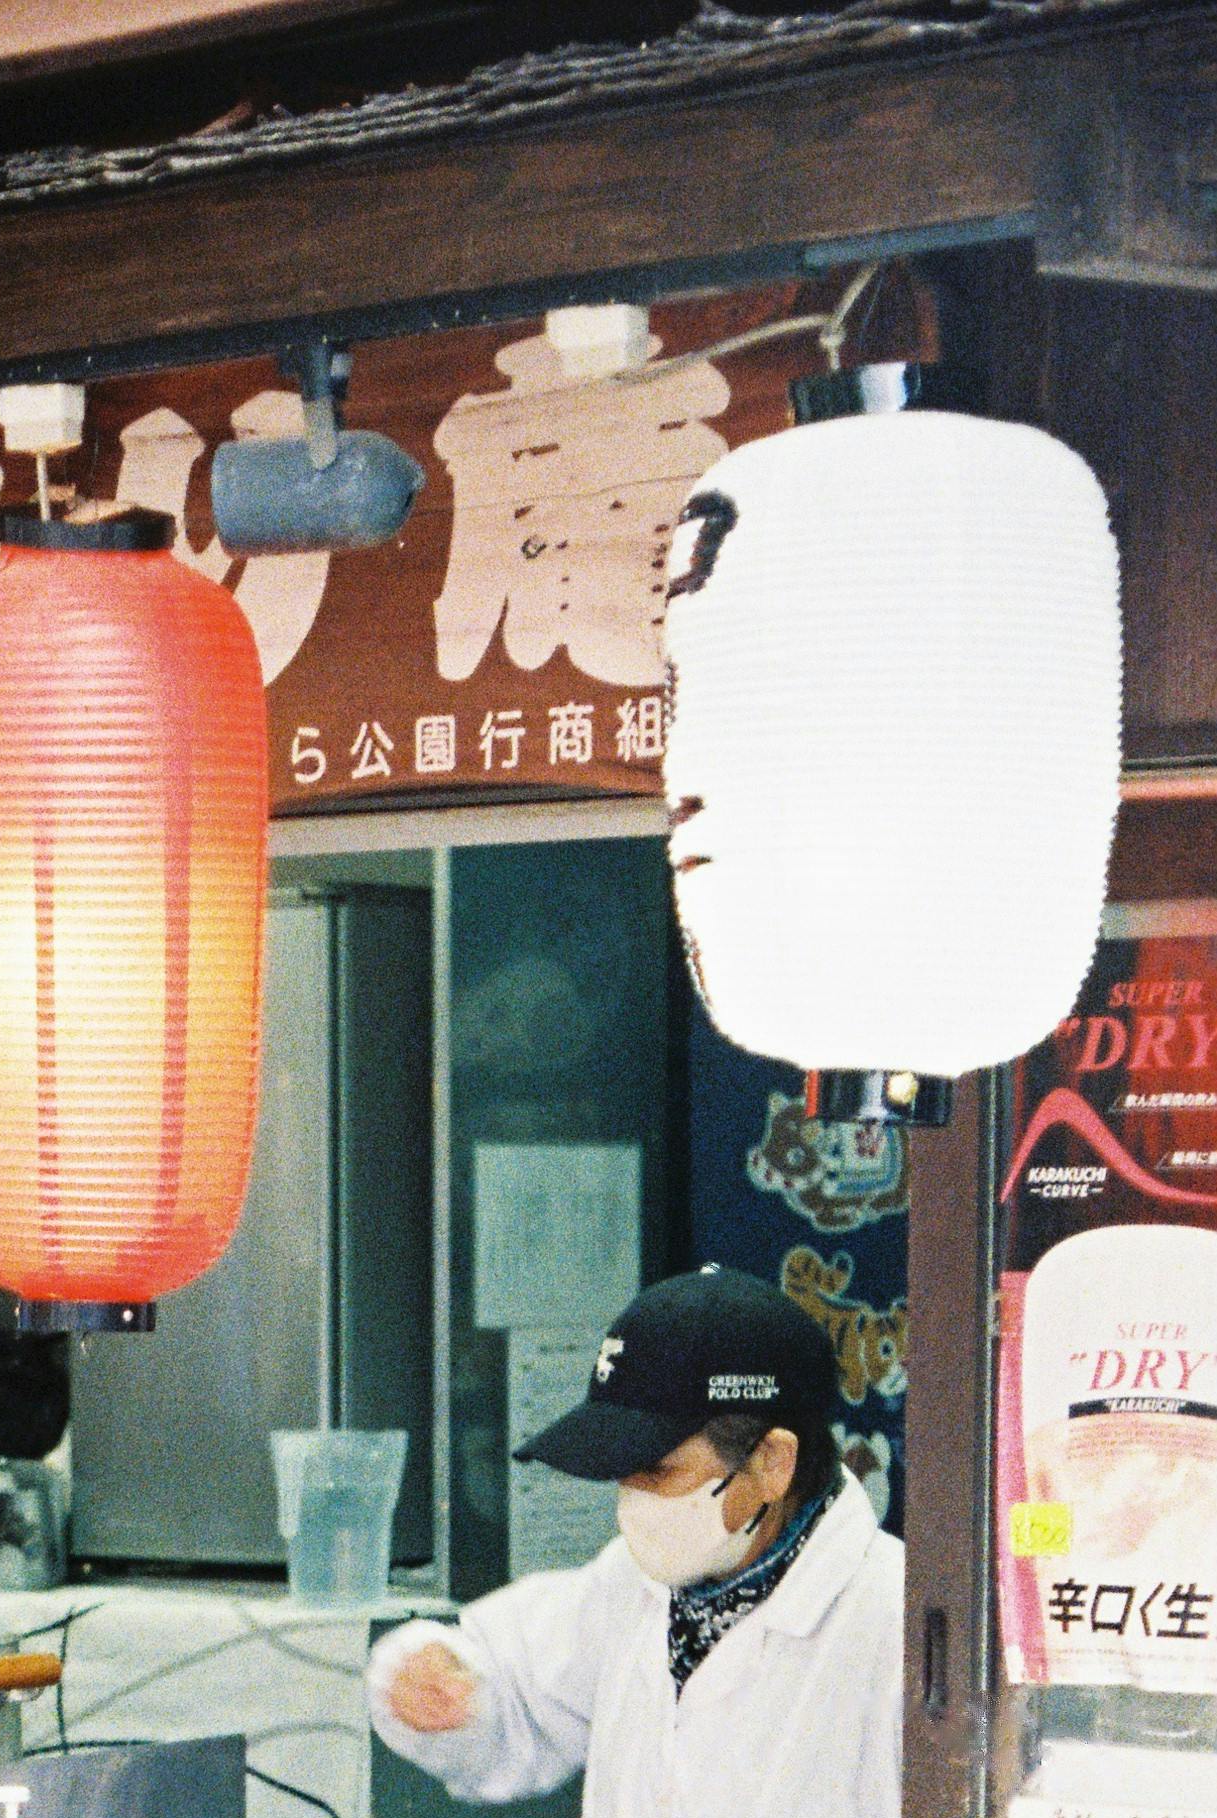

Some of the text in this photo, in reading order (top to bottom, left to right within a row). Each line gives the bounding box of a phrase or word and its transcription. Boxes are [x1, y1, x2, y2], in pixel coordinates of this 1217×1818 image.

[1108, 980, 1204, 1008] SUPER
[1026, 1166, 1108, 1184] KARAKUCHI
[1115, 1320, 1188, 1343] SUPER
[708, 1386, 741, 1401] POLO
